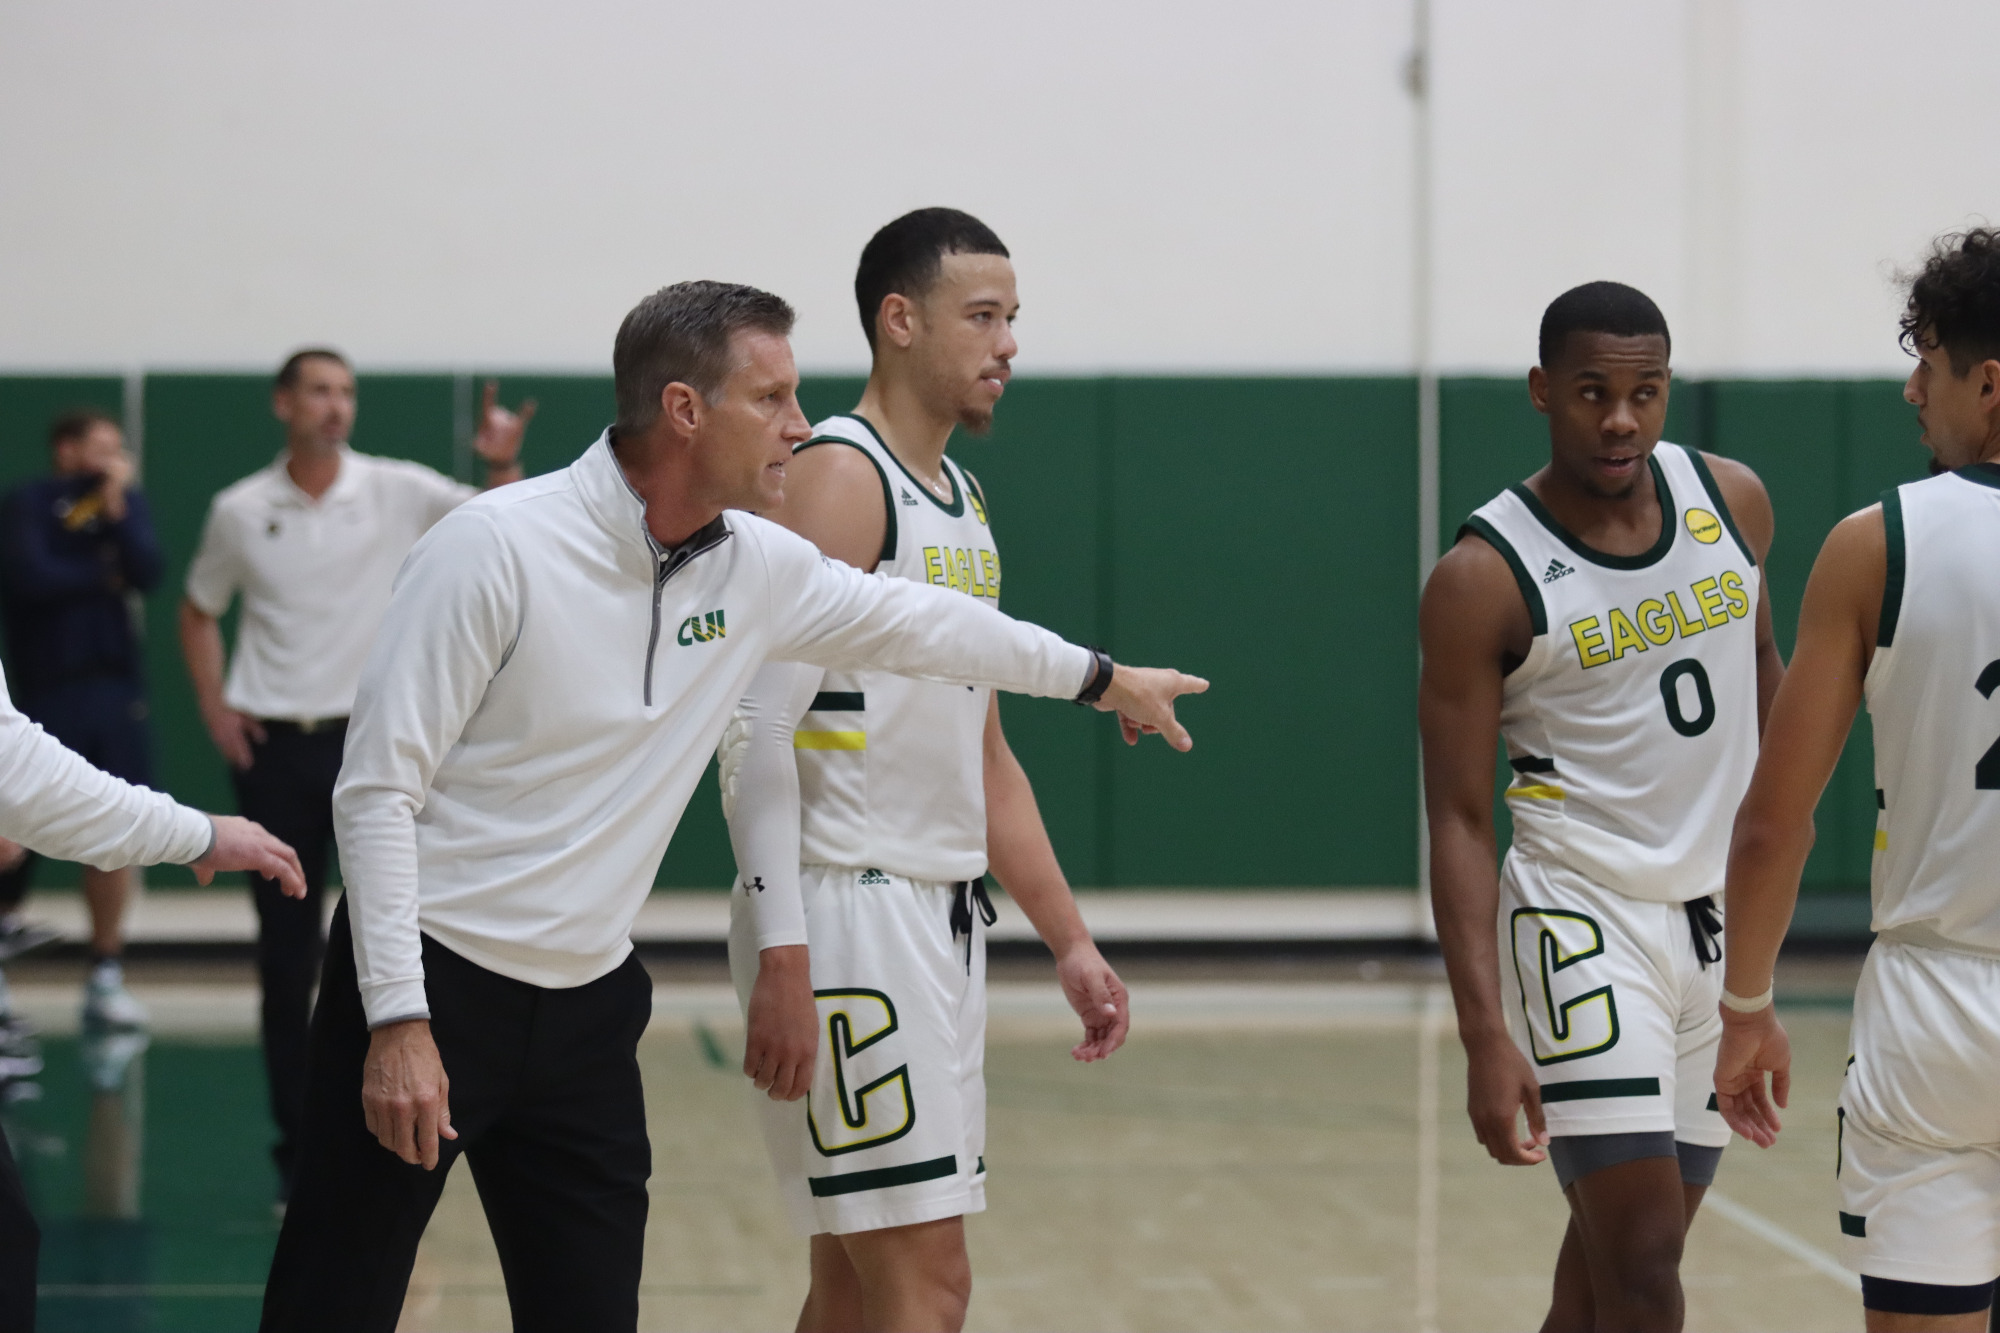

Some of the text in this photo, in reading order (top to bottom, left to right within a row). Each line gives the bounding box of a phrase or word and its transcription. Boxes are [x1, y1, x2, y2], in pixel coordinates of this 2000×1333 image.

[677, 609, 726, 647] CUI
[1569, 570, 1749, 670] EAGLES
[1659, 658, 1716, 737] 0
[1511, 907, 1620, 1067] C
[808, 987, 916, 1157] C
